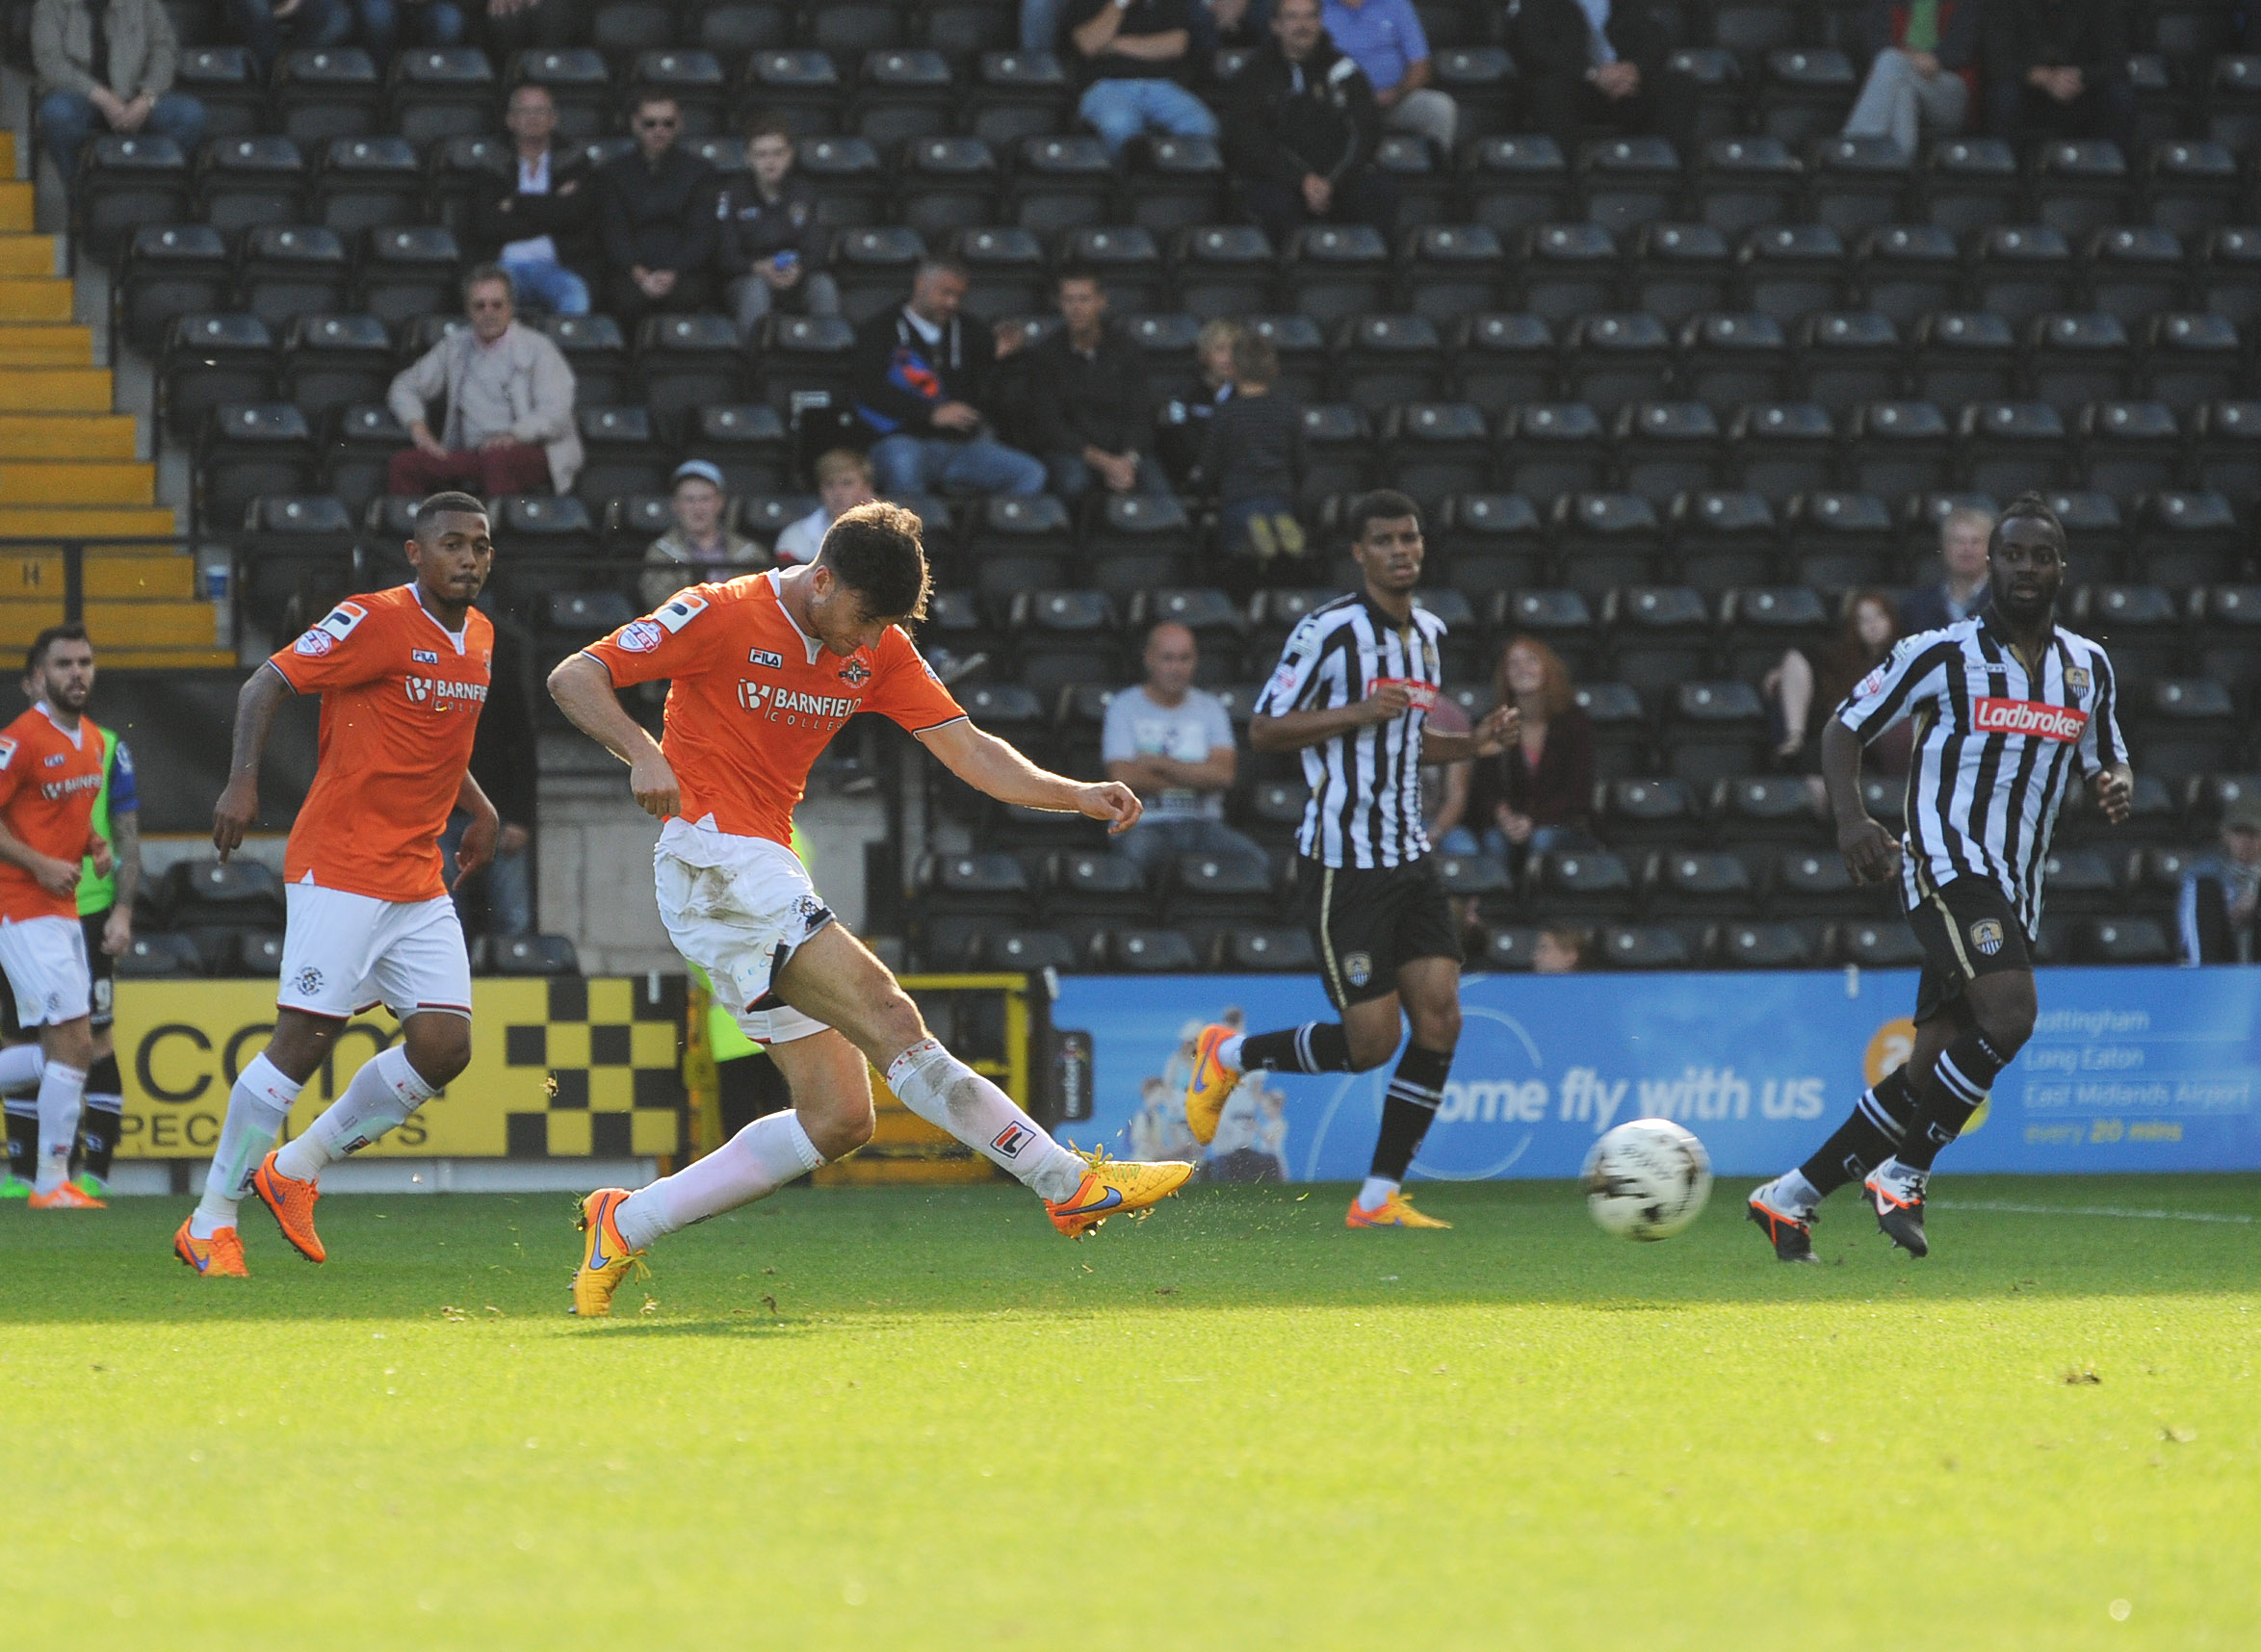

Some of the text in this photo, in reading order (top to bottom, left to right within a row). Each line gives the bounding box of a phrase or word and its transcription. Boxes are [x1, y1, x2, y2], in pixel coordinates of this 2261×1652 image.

[752, 650, 779, 666] FILA
[437, 680, 488, 703] BARNFIE
[1978, 701, 2085, 738] Ladbrokes
[2081, 1047, 2145, 1070] Eaton
[1435, 1066, 1825, 1134] ome fly with us
[2025, 1080, 2250, 1107] East Midlands Airport
